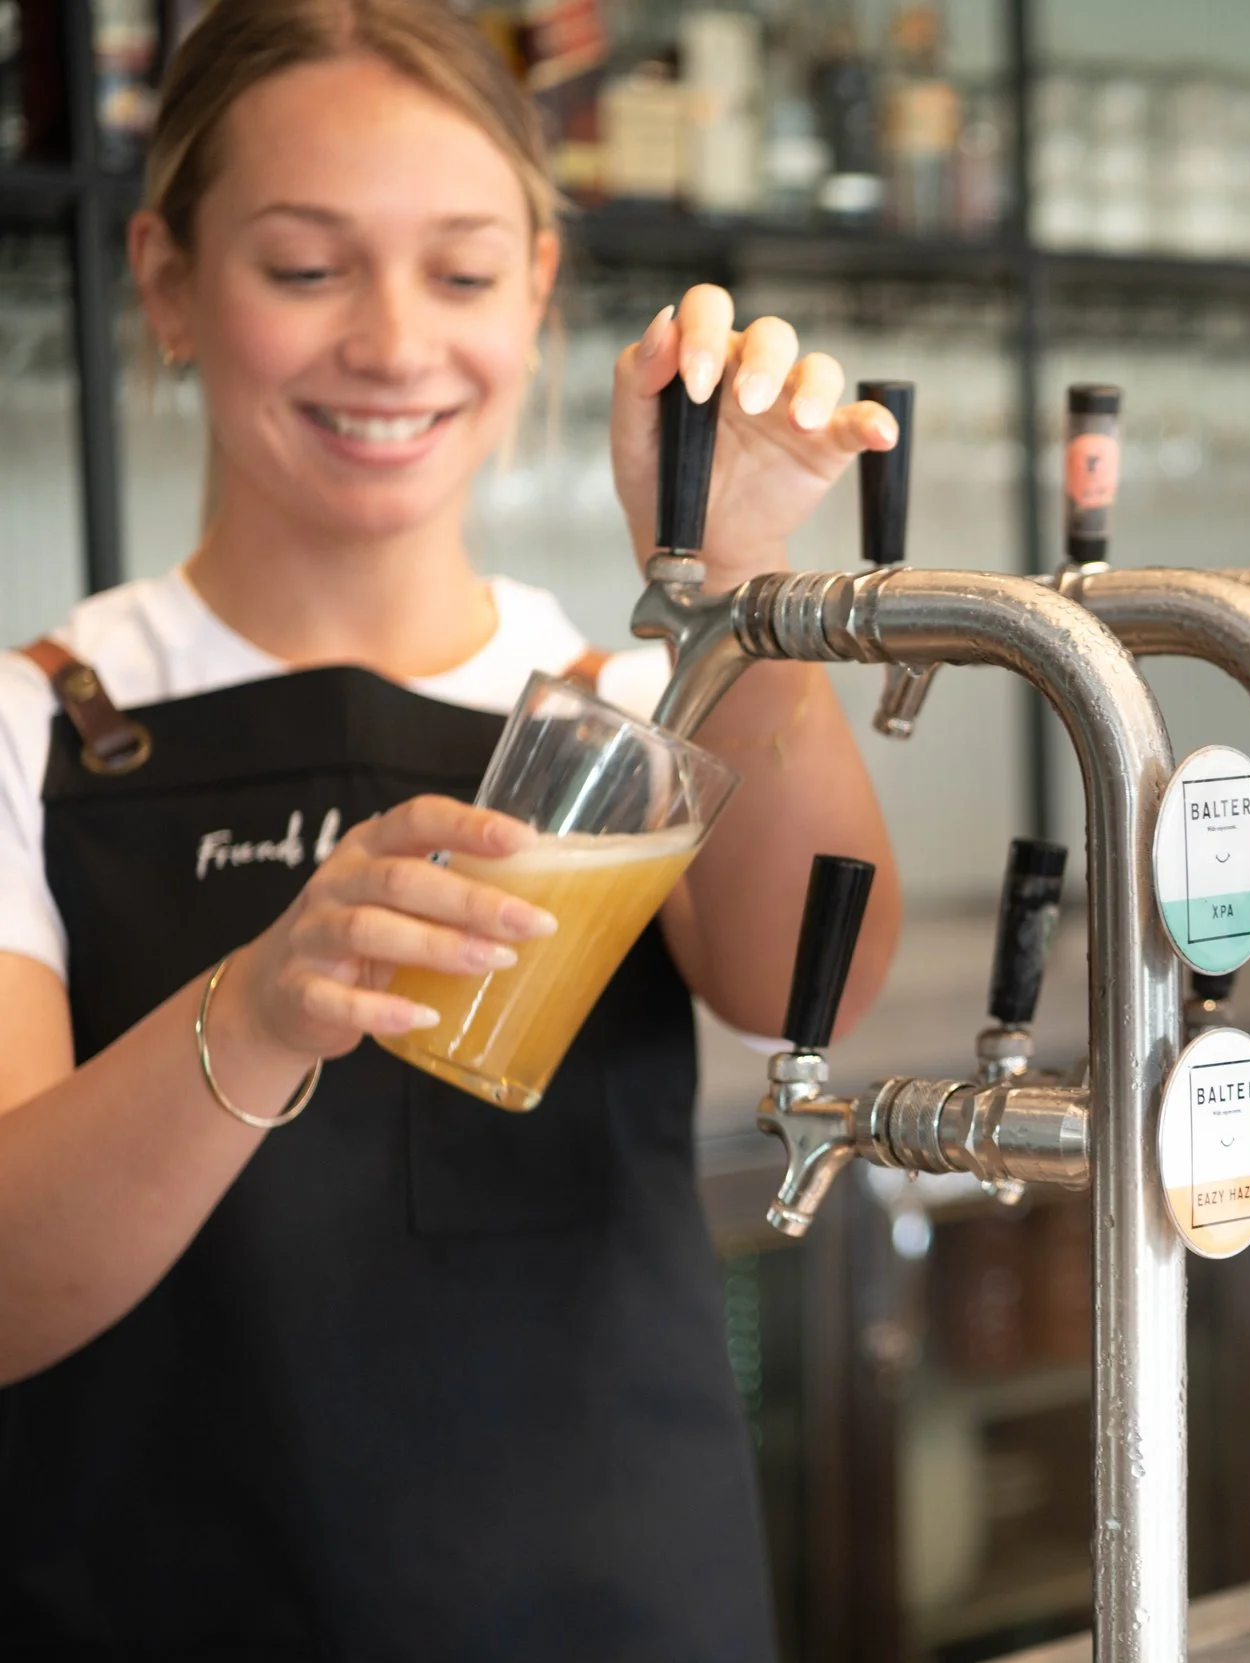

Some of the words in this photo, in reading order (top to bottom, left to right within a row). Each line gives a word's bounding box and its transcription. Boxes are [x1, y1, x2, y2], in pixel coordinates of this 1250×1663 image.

[1191, 797, 1250, 820] BALTER
[1211, 903, 1234, 919] XPA
[1197, 1189, 1224, 1207] EAZY
